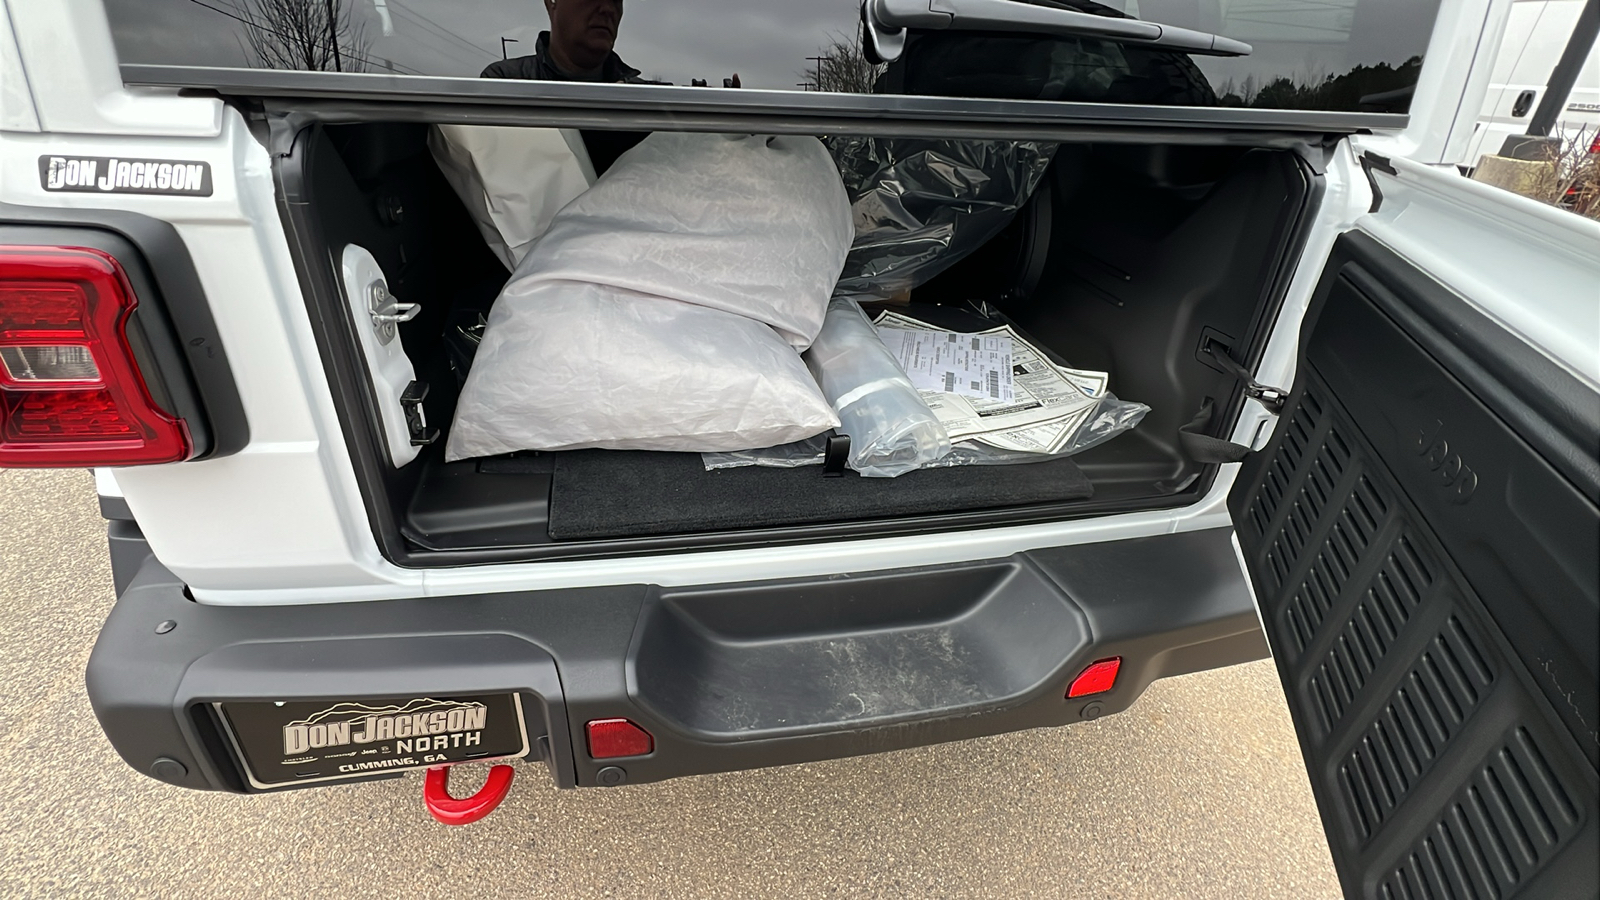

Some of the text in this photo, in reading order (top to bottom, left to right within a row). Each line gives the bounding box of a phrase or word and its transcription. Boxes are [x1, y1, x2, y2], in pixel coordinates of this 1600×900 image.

[47, 156, 203, 191] DON JACKSON
[284, 706, 488, 756] DON JACKSON
[396, 732, 481, 755] NORTH
[338, 753, 448, 773] CUMMING, GA
